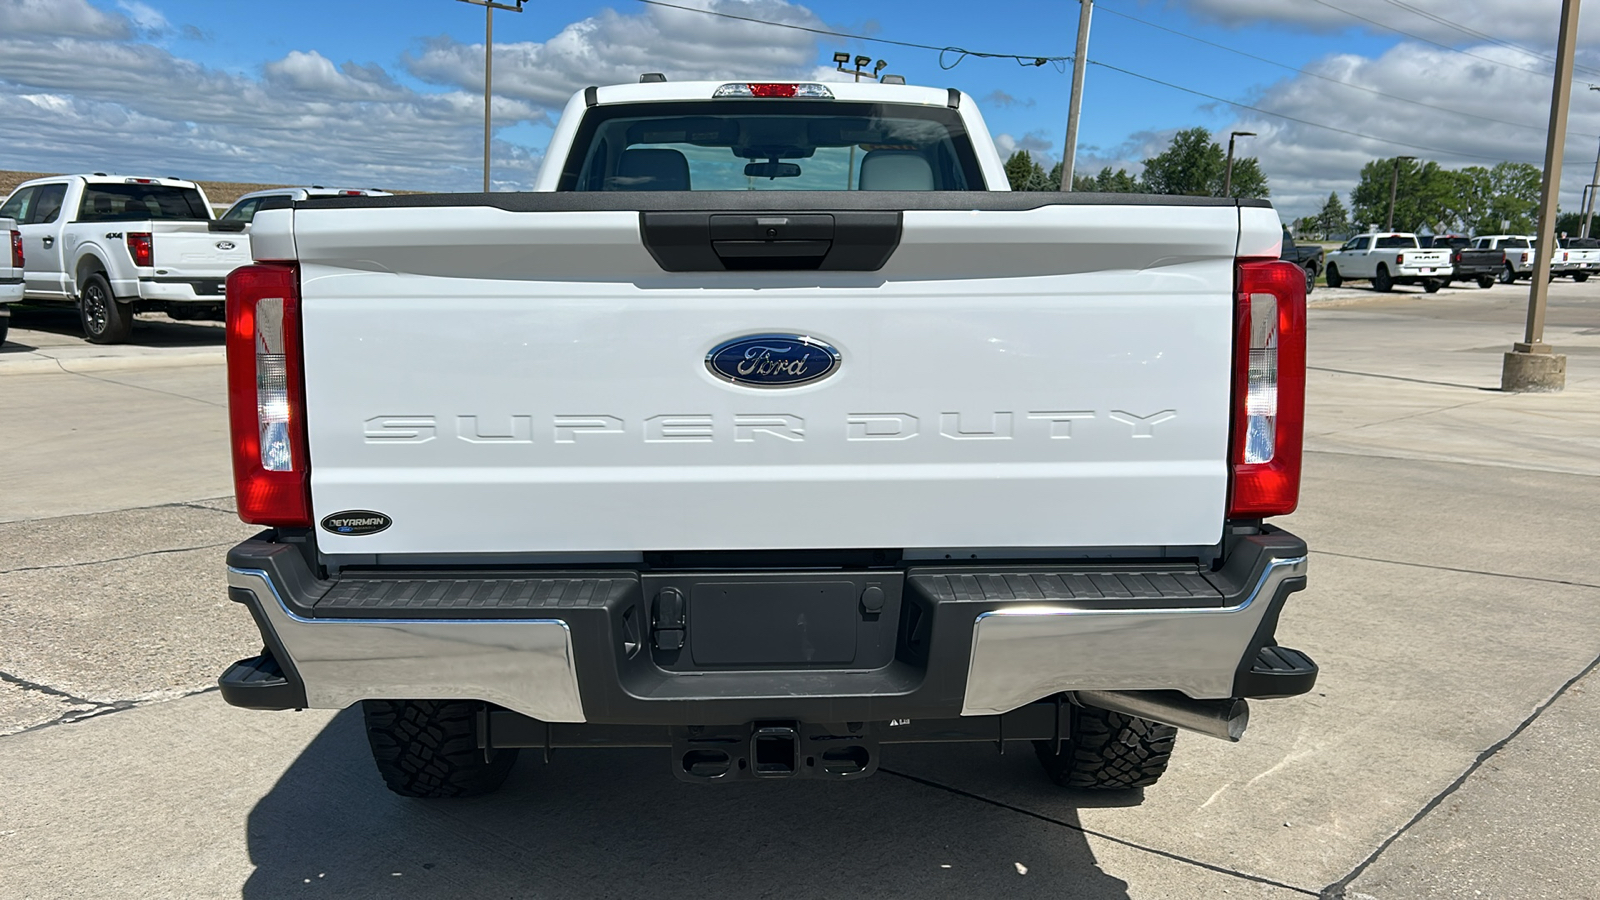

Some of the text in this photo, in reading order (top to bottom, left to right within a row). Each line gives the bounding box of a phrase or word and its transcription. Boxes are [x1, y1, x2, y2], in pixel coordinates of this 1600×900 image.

[737, 346, 810, 376] Ford
[363, 409, 1178, 444] SUPER DUTY
[328, 517, 384, 527] DEYARMAN
